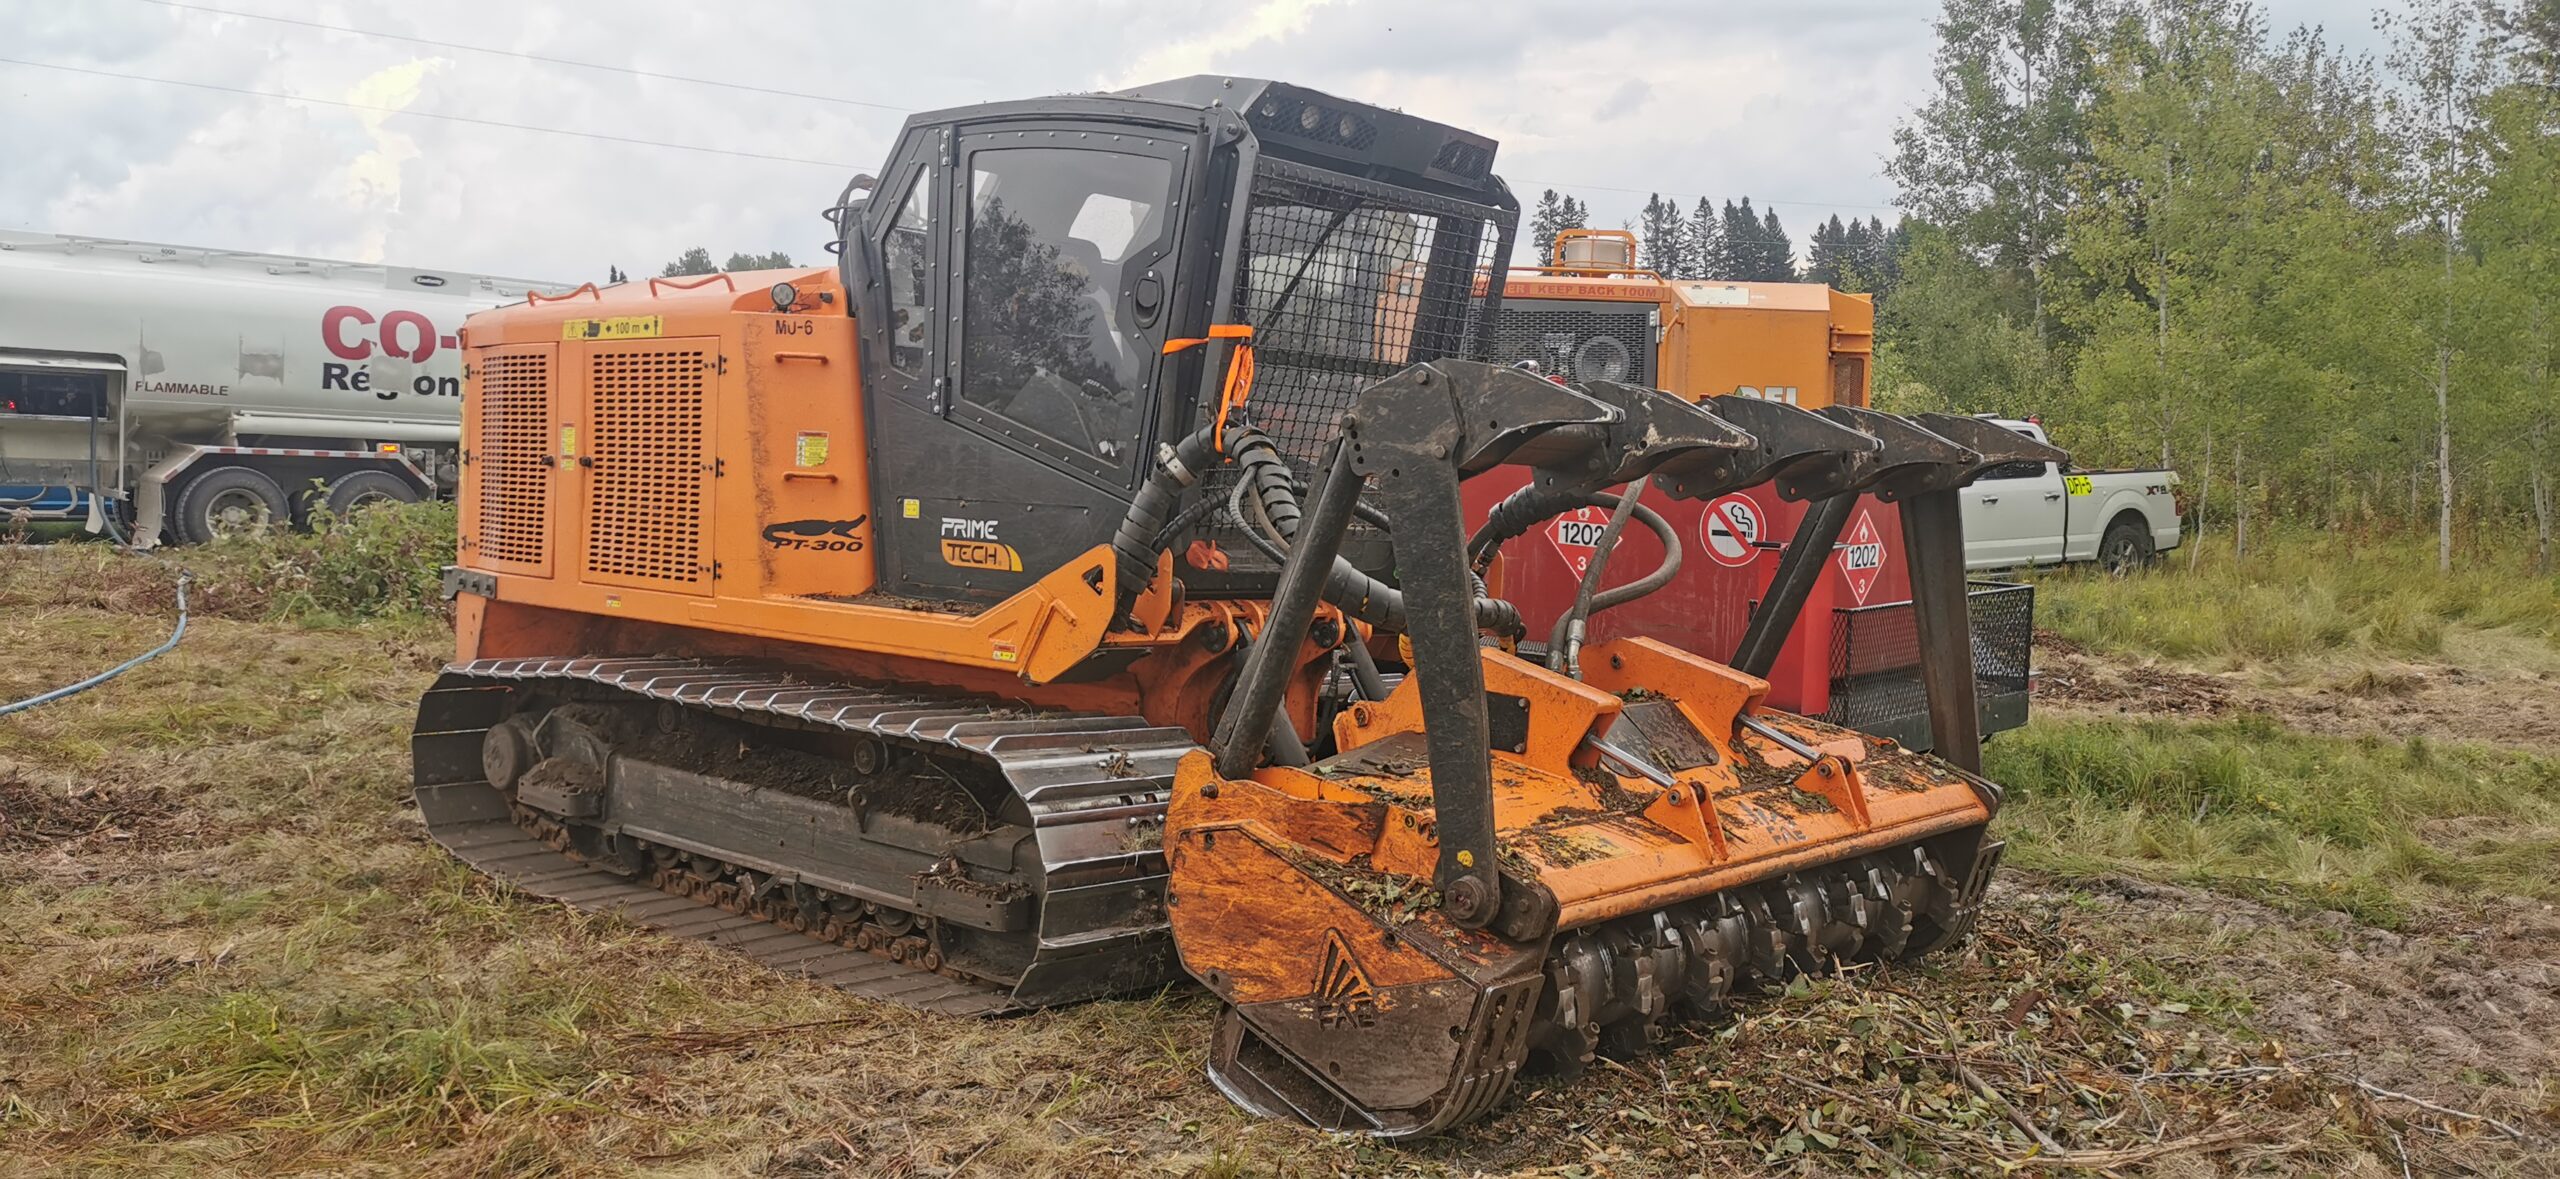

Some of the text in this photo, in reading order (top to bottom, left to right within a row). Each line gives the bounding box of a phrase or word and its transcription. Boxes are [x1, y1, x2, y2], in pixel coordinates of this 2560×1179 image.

[1537, 284, 1573, 295] KEEP
[1578, 286, 1615, 296] BACK
[1621, 287, 1657, 297] 100M
[615, 321, 641, 335] 100 m
[775, 319, 814, 336] MU-6
[134, 381, 230, 397] FLAMMABLE
[941, 518, 999, 540] PRIME
[1561, 522, 1605, 546] 1202
[773, 539, 864, 552] PT-300
[946, 543, 998, 566] TECH
[1849, 545, 1877, 568] 1202
[1576, 556, 1587, 571] 3
[1858, 578, 1866, 594] 3
[1319, 1001, 1376, 1031] FAE
